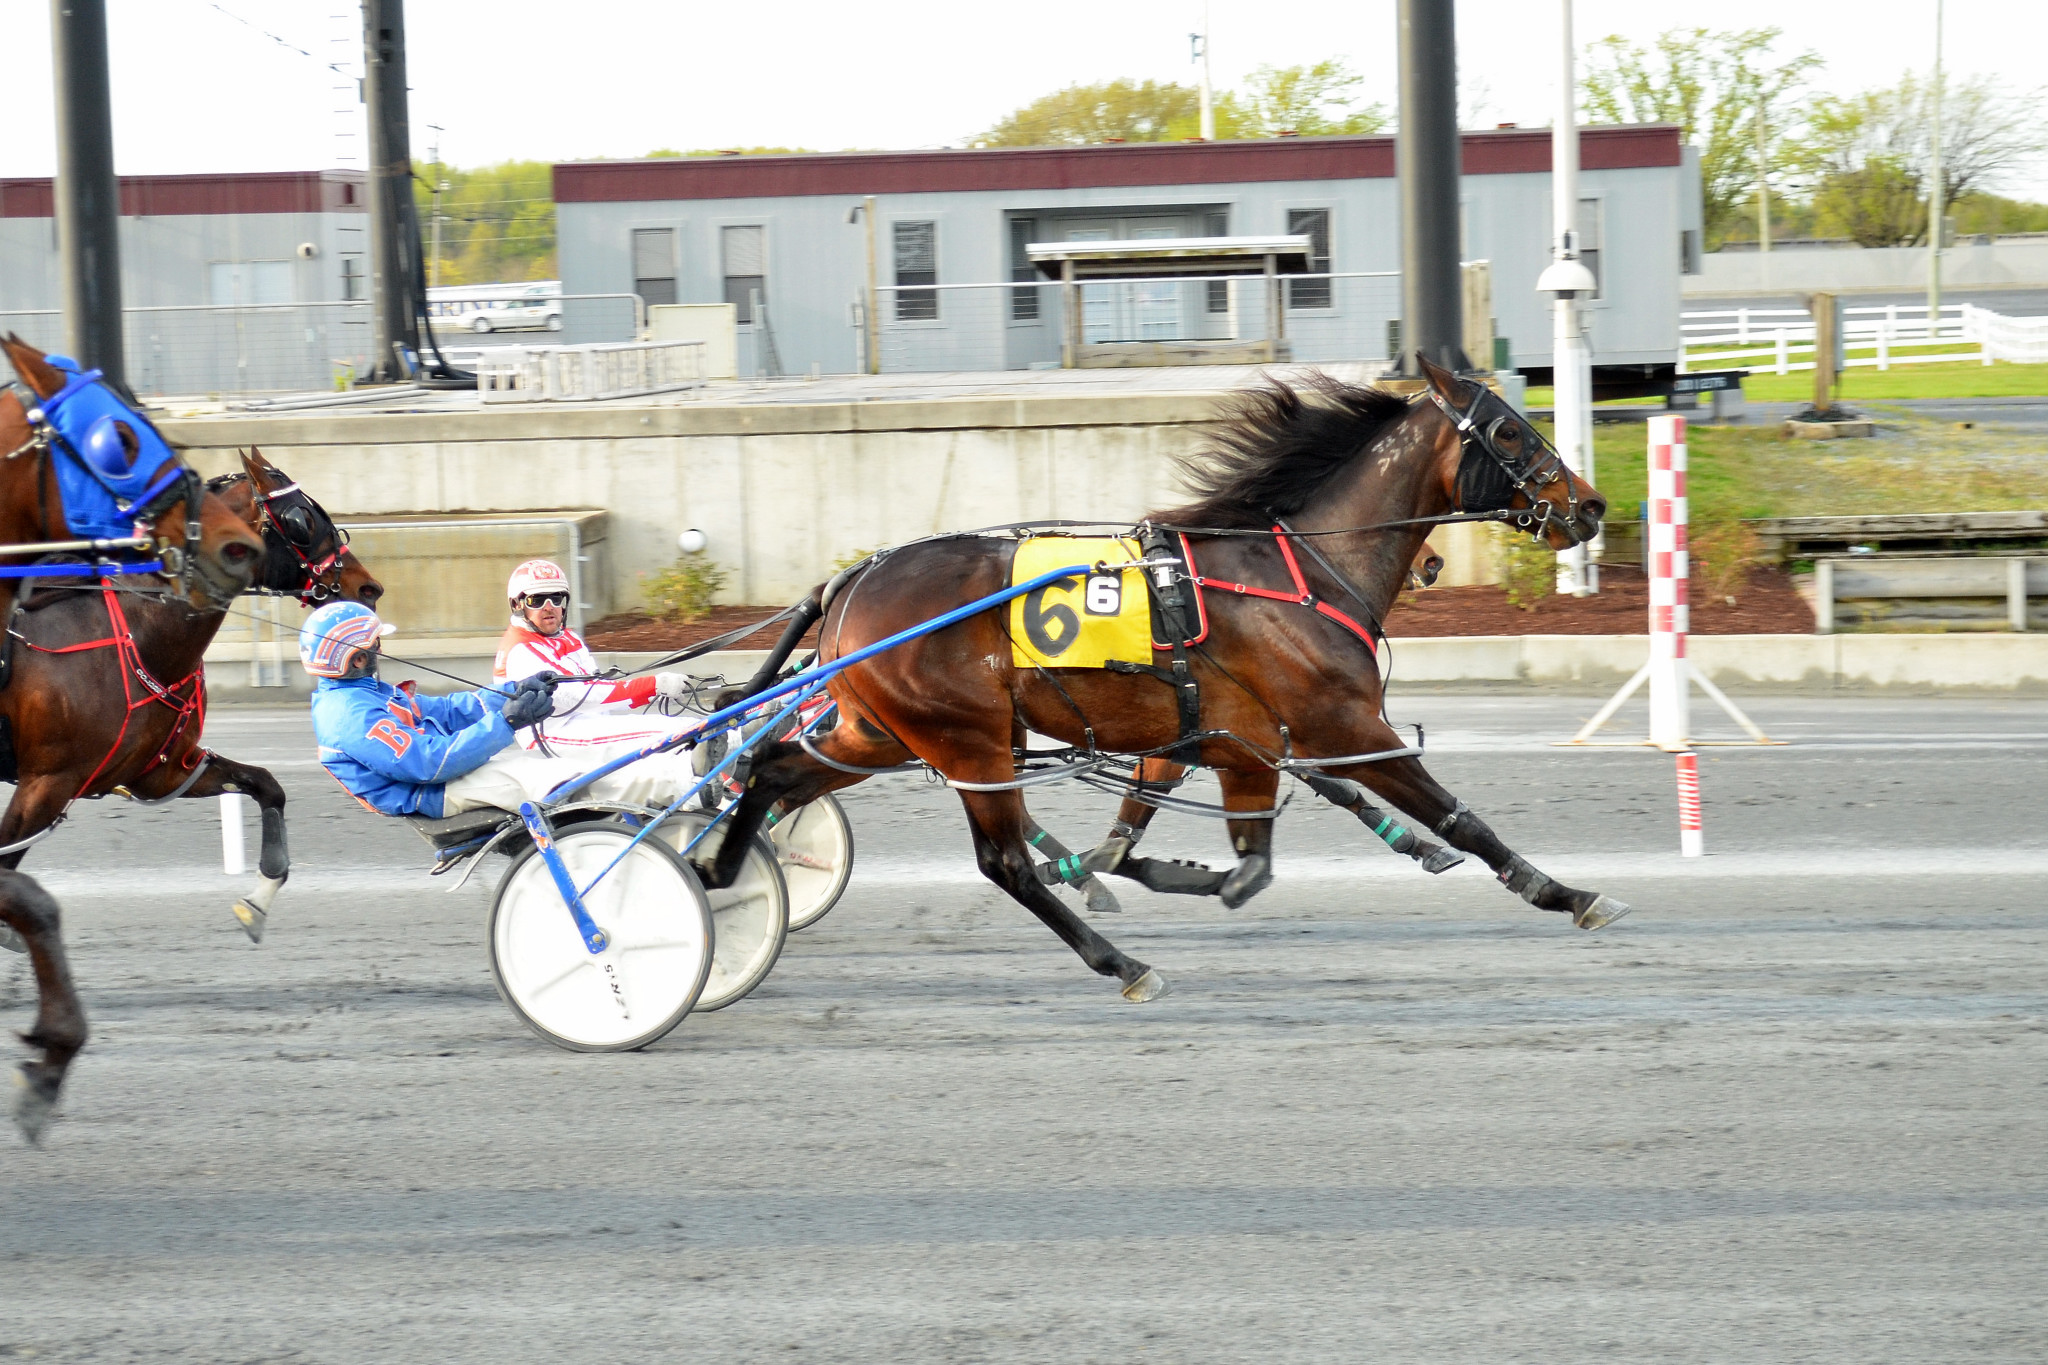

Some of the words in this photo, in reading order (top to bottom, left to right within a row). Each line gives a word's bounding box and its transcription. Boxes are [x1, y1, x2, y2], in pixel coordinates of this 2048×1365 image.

[1087, 576, 1119, 613] 6
[1023, 576, 1080, 658] 6
[365, 719, 412, 759] B
